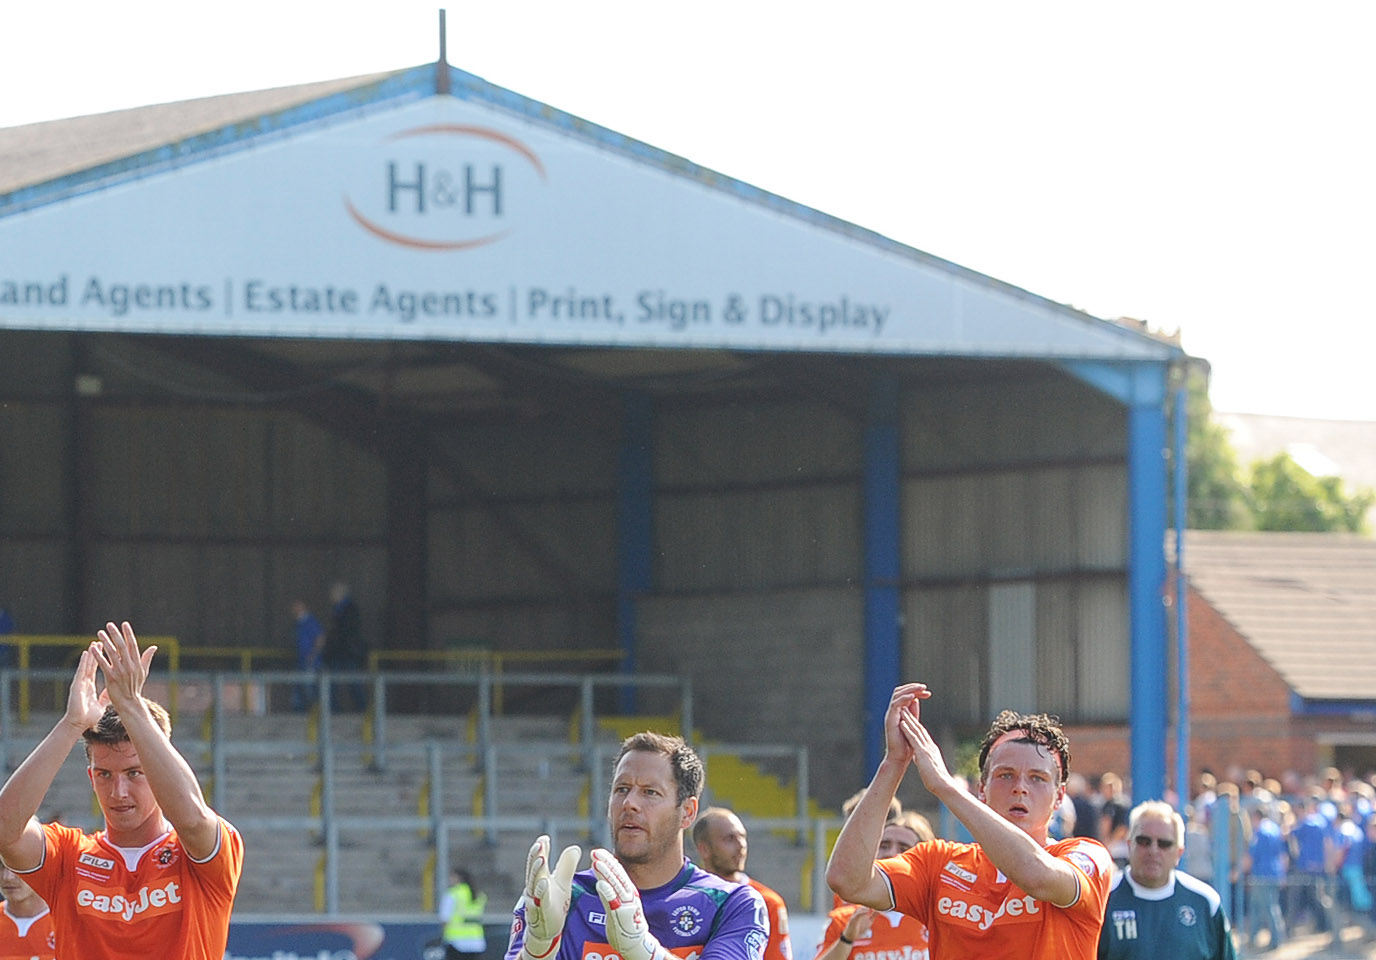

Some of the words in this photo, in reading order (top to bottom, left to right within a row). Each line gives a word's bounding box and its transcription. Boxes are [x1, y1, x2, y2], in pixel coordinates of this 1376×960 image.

[386, 160, 504, 217] H&H
[84, 277, 213, 314] Agents
[245, 281, 358, 314] Estate
[370, 284, 497, 322] Agents
[528, 289, 624, 326] Print,
[636, 291, 711, 331] Sign
[723, 298, 750, 325] &
[760, 295, 891, 336] Display
[82, 855, 110, 868] FILA
[77, 880, 182, 922] easyJet
[1113, 919, 1138, 941] TH
